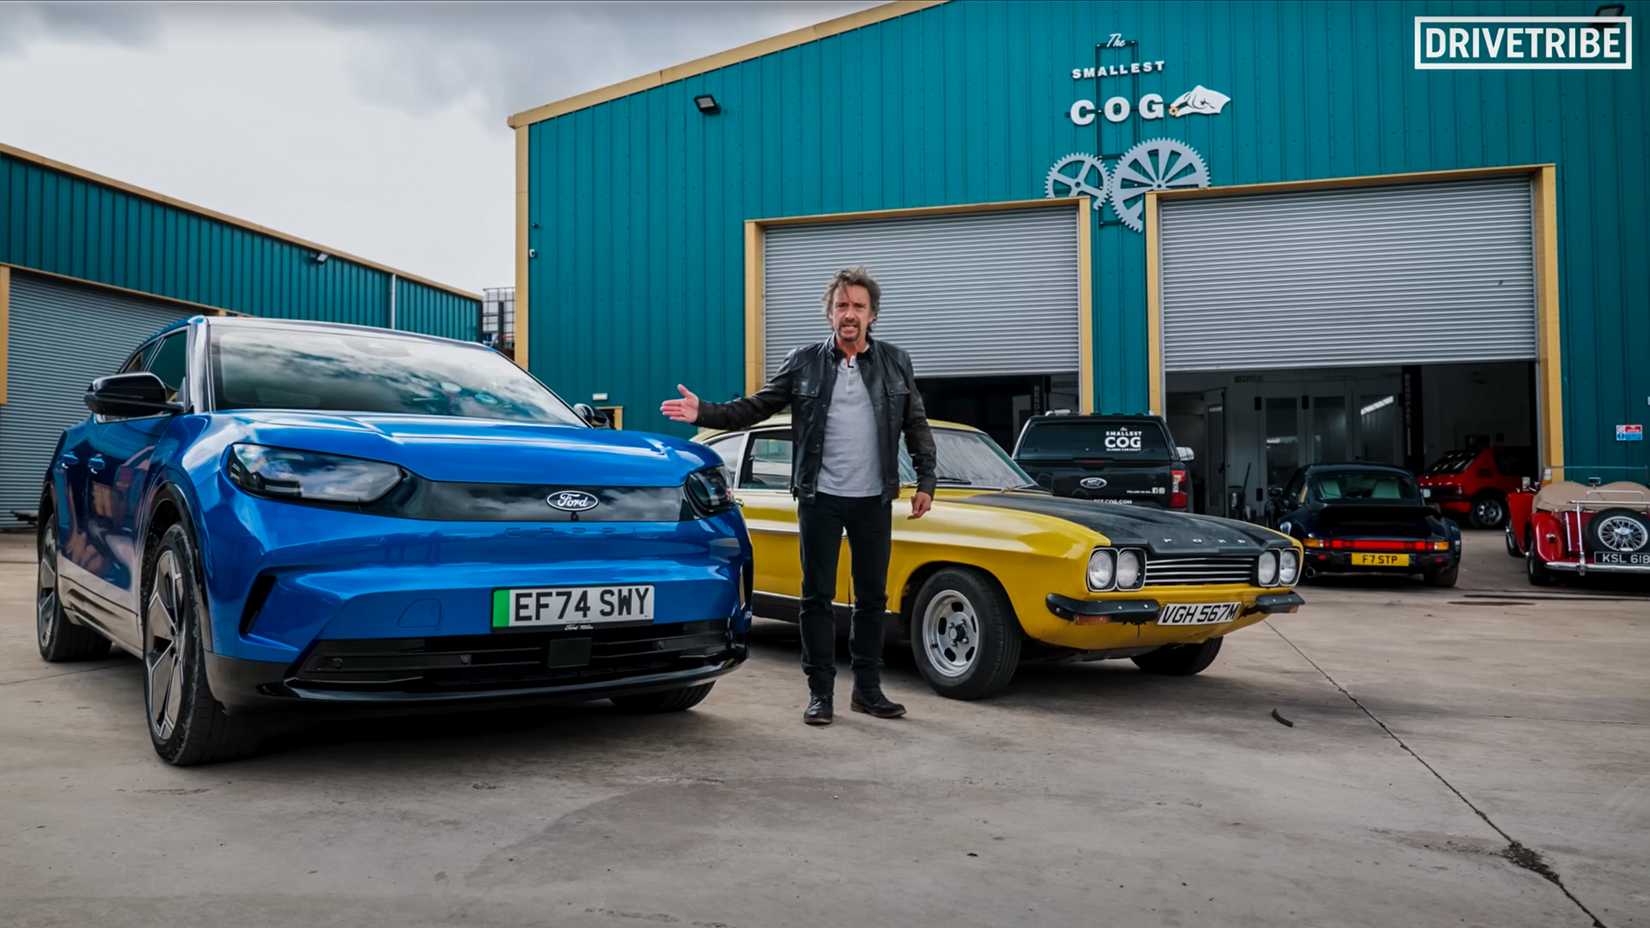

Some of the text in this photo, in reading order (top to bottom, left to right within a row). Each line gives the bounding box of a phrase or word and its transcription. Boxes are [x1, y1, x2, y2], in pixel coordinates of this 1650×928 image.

[1106, 33, 1126, 48] The
[1071, 60, 1165, 80] SMALLEST
[1069, 93, 1165, 125] COG
[1104, 436, 1142, 448] COG
[556, 492, 588, 508] Ford
[1378, 554, 1398, 564] STP
[1602, 552, 1627, 563] KSL
[515, 588, 649, 622] EF74 SWY
[1162, 604, 1239, 624] VGH 567M
